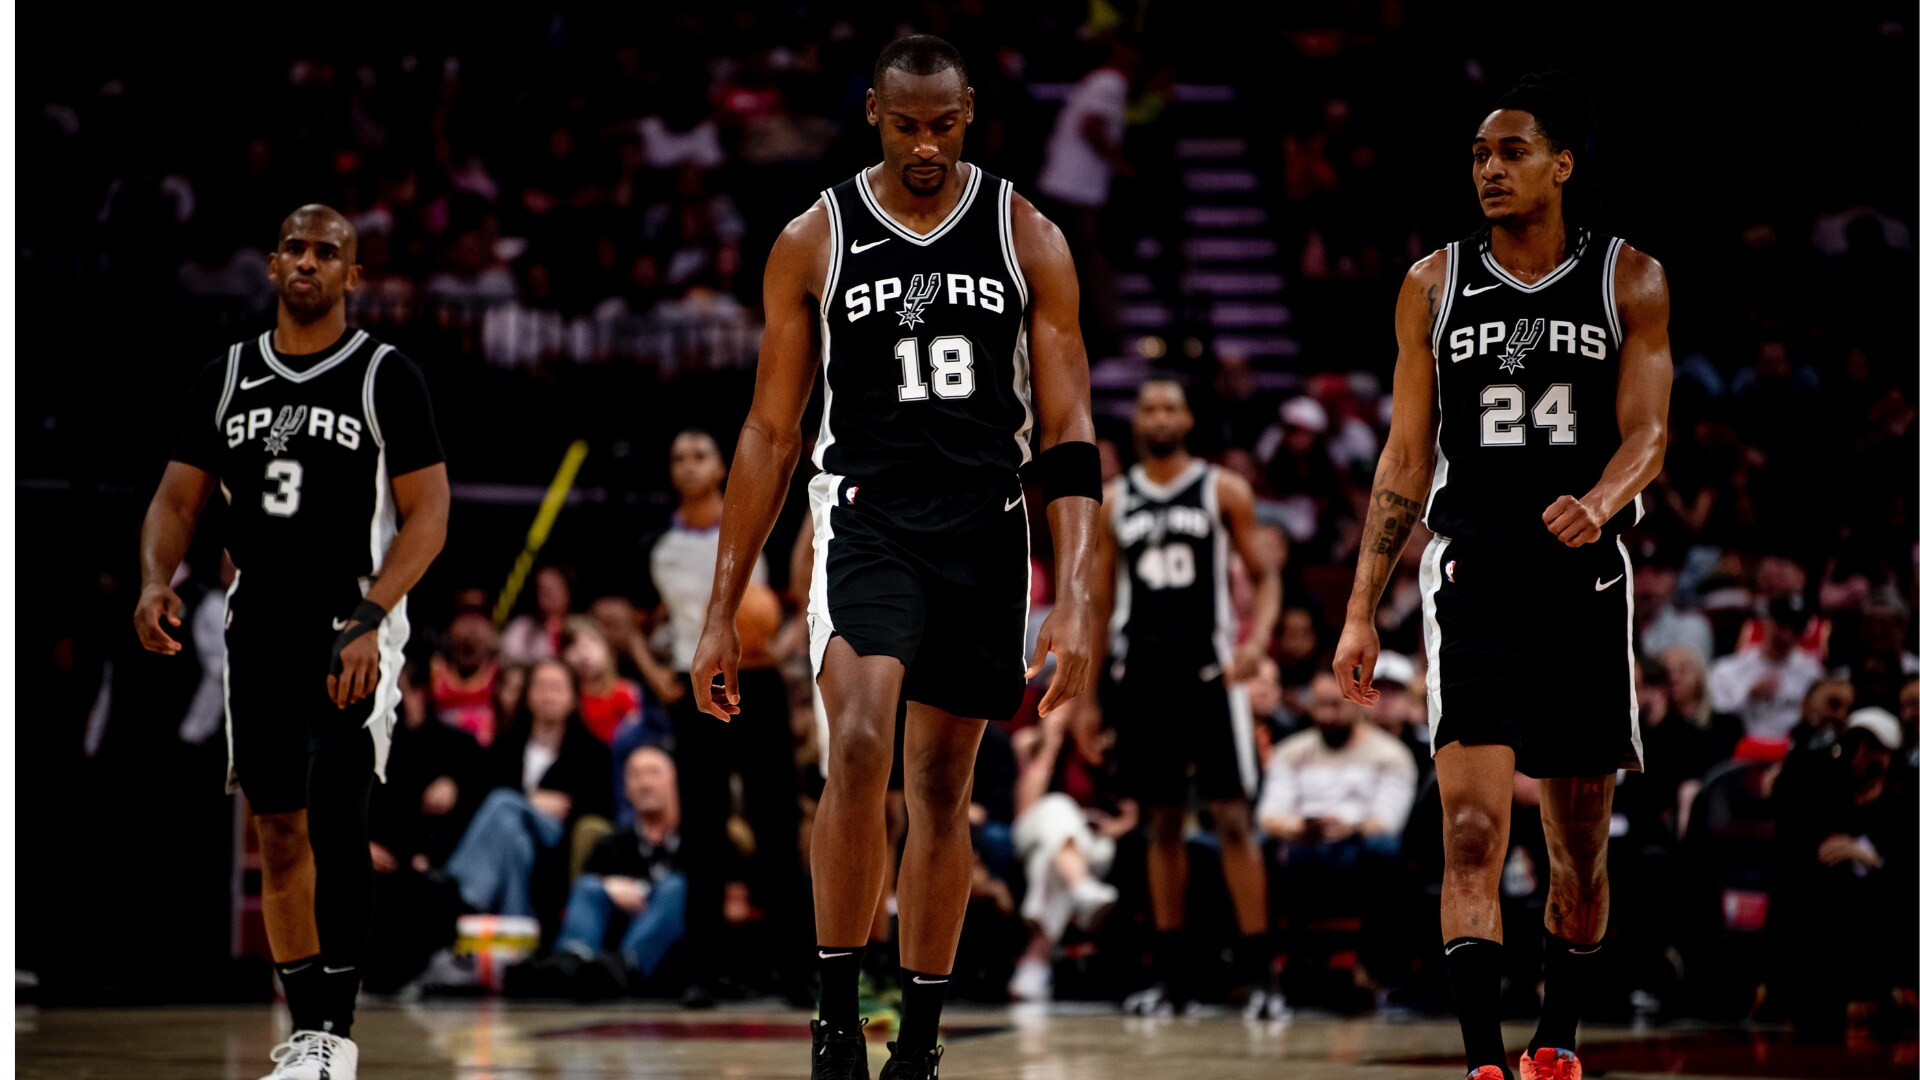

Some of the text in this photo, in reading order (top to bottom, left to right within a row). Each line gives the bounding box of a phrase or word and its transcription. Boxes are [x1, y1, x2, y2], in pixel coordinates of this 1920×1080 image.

[845, 273, 1004, 330] SPURS
[894, 335, 976, 402] 18
[1450, 318, 1606, 375] SPURS
[226, 405, 362, 456] SPURS
[1480, 383, 1577, 447] 24
[262, 459, 303, 517] 3
[1137, 543, 1196, 590] 40
